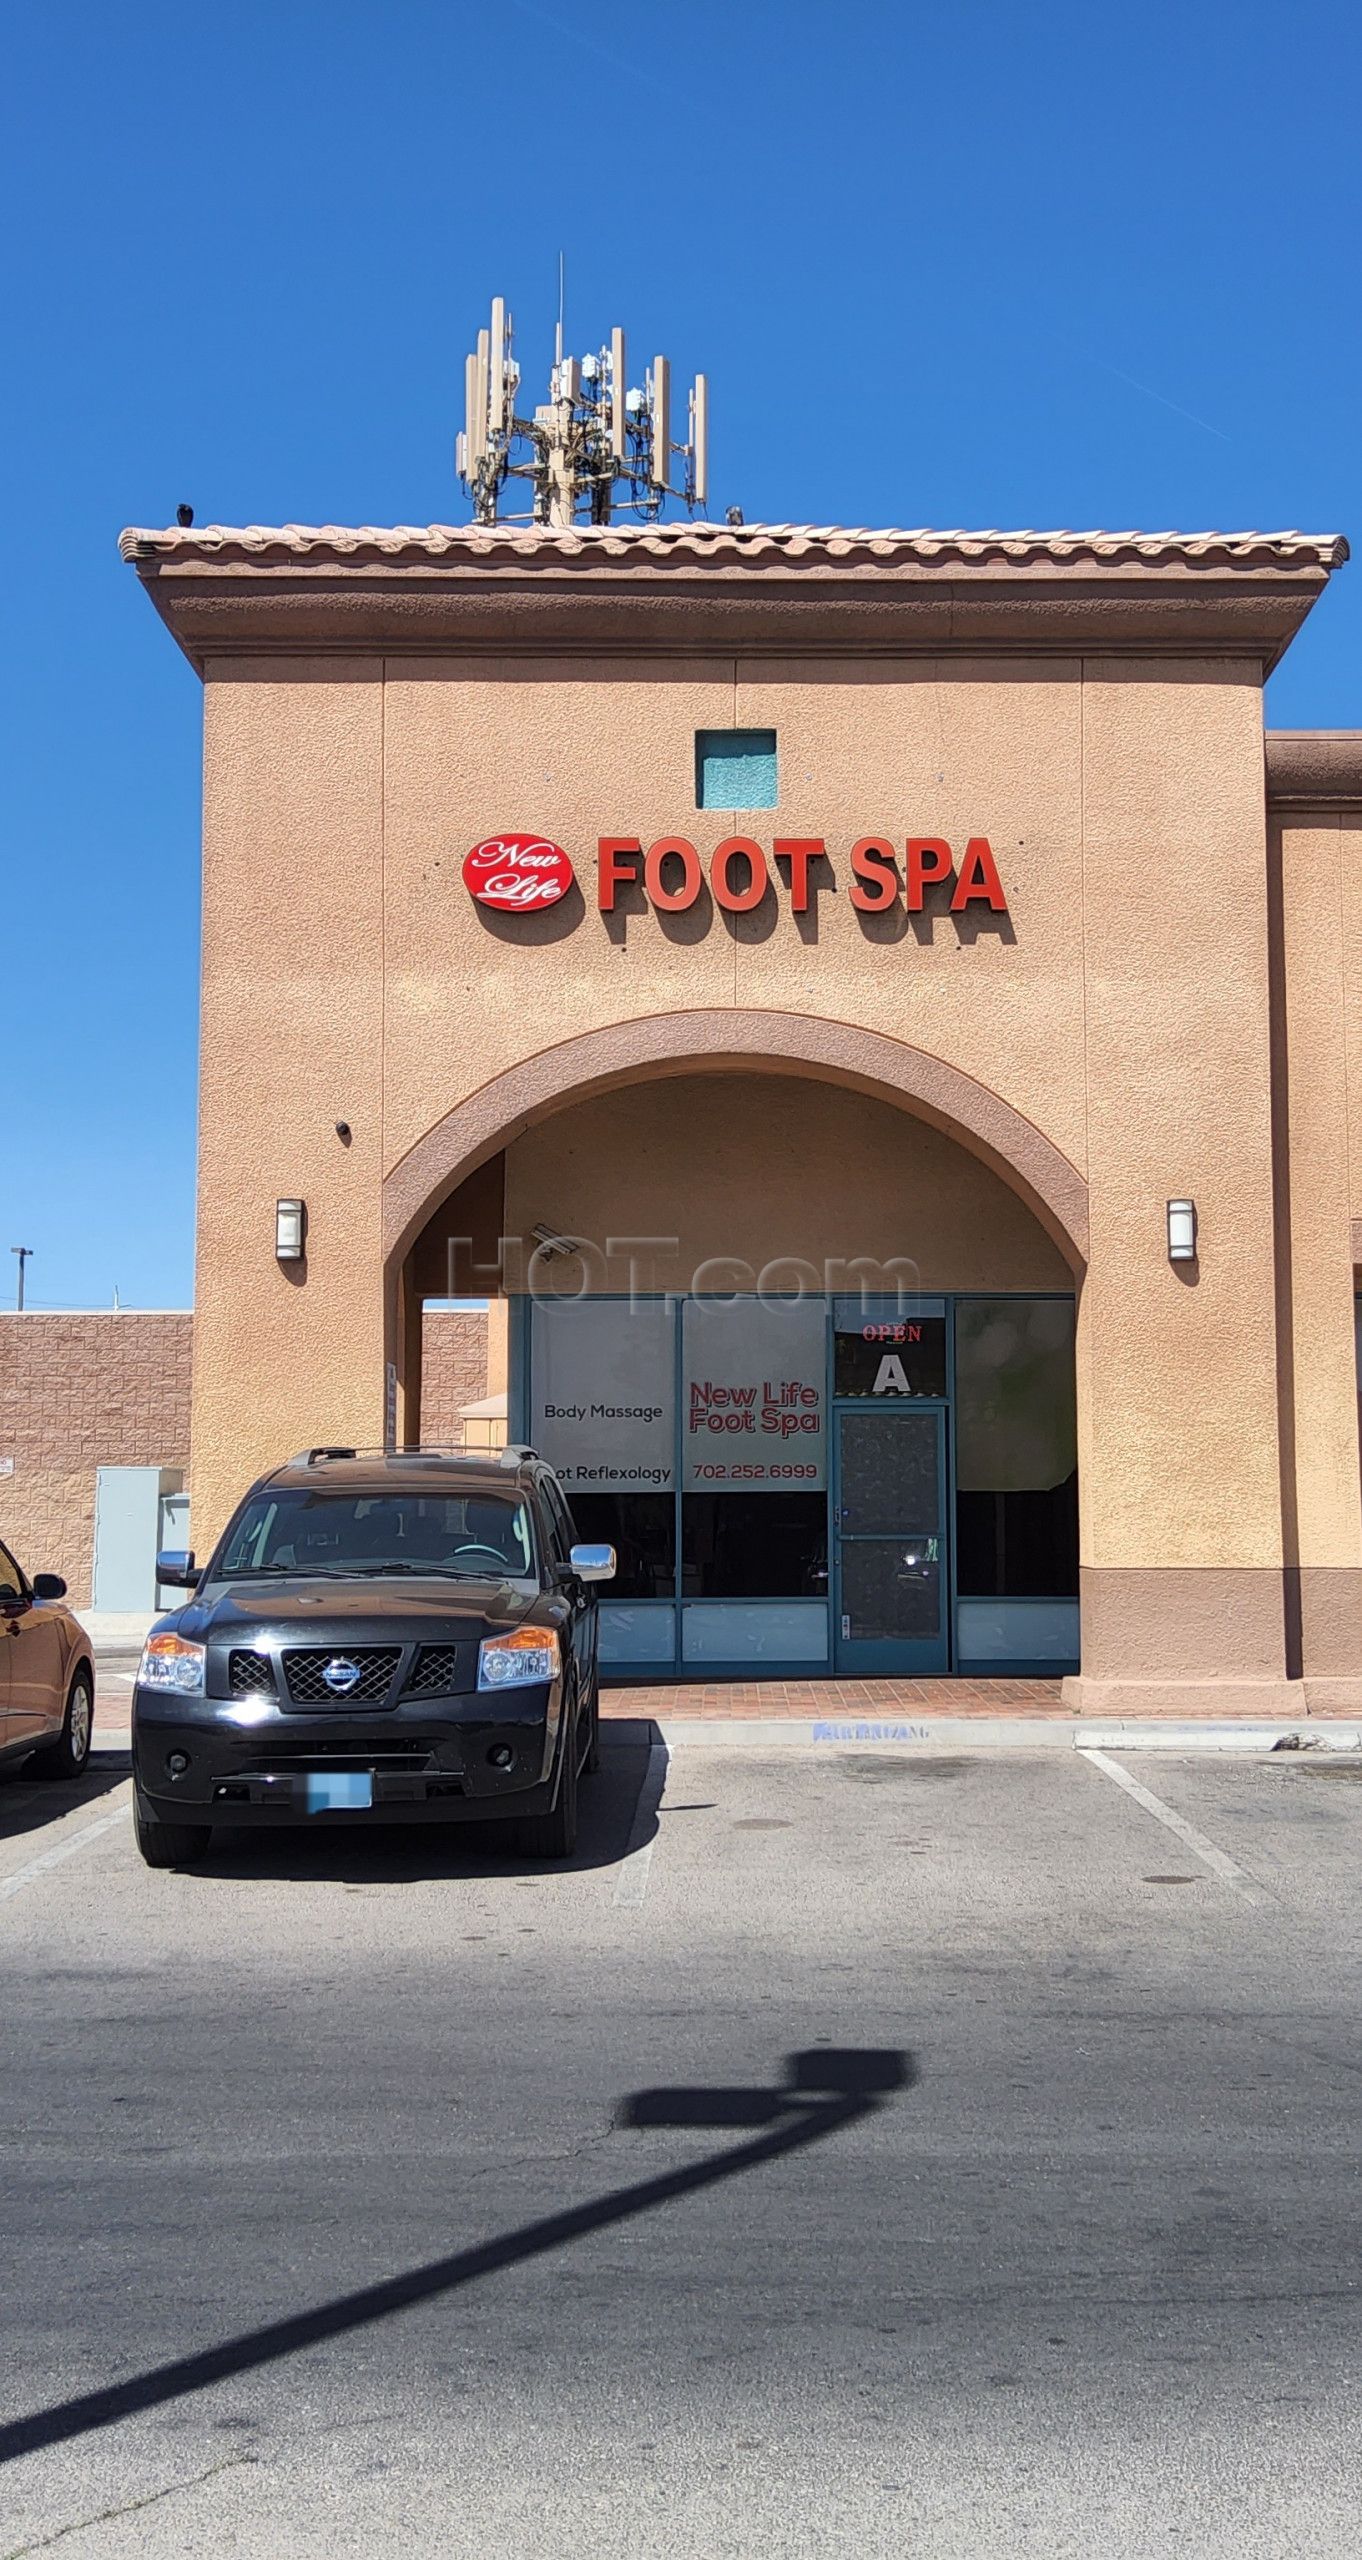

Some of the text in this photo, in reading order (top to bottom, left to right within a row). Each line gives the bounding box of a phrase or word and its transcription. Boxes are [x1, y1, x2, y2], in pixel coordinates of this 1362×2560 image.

[471, 841, 561, 867] New
[599, 836, 1007, 911] FOOT SPA
[477, 873, 561, 906] Life
[862, 1324, 922, 1342] OPEN
[872, 1354, 912, 1392] A
[689, 1381, 819, 1408] New Life
[544, 1405, 663, 1422] Body Massage
[689, 1408, 819, 1439] Foot Spa
[555, 1466, 671, 1484] ot Reflexology
[692, 1465, 817, 1479] 702.252.6999
